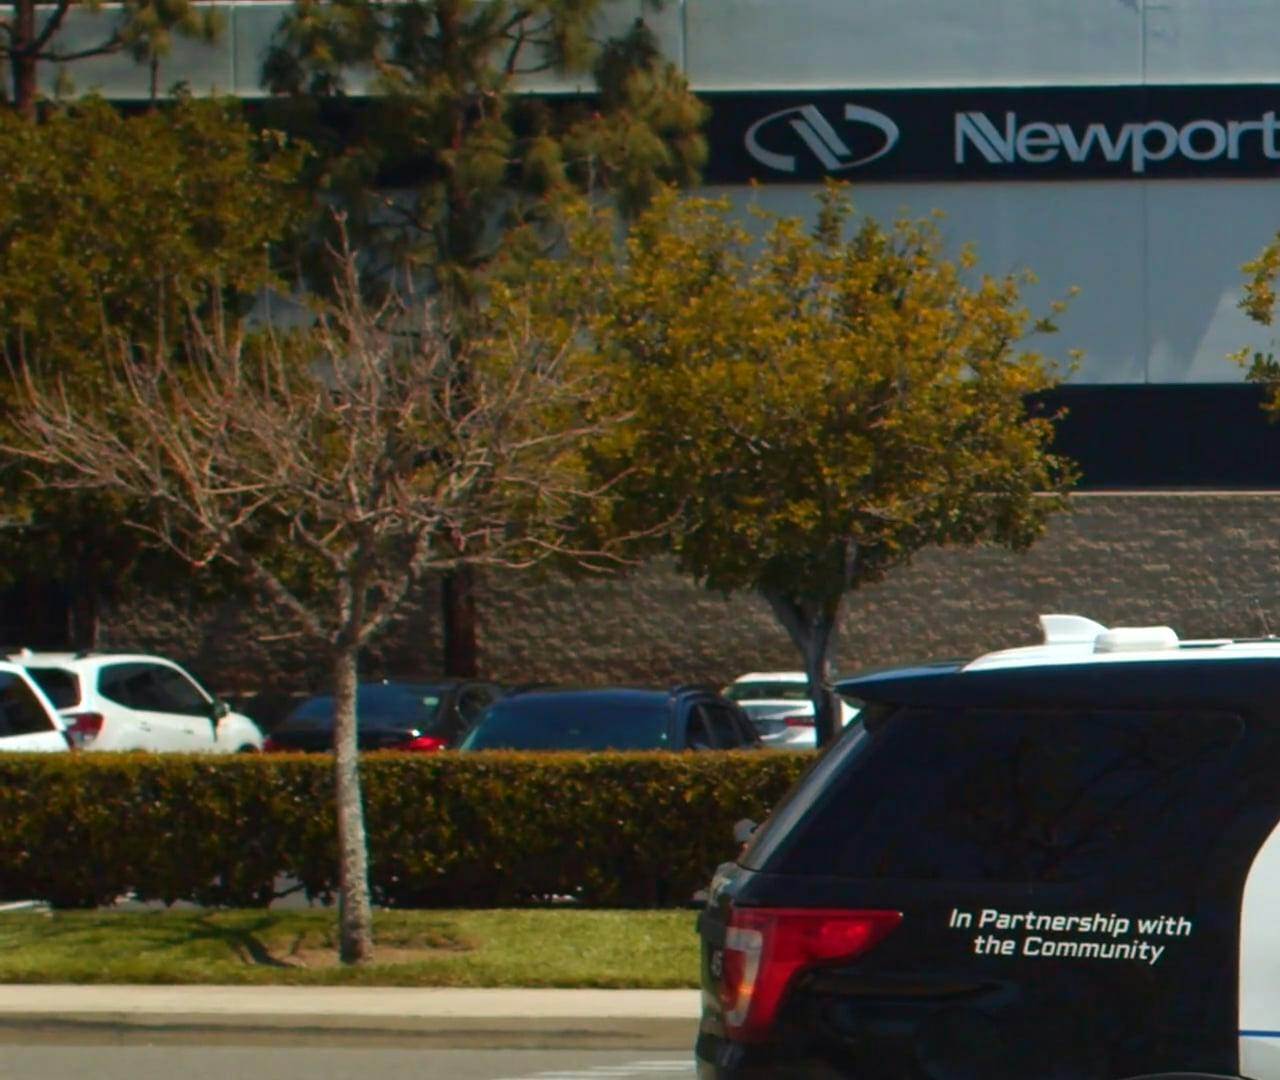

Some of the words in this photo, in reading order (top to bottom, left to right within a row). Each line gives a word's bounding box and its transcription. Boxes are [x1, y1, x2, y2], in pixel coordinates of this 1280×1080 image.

[949, 908, 972, 929] In
[978, 909, 1129, 938] Partnership
[1137, 915, 1192, 936] with
[973, 935, 1015, 955] the
[1023, 936, 1165, 965] Community
